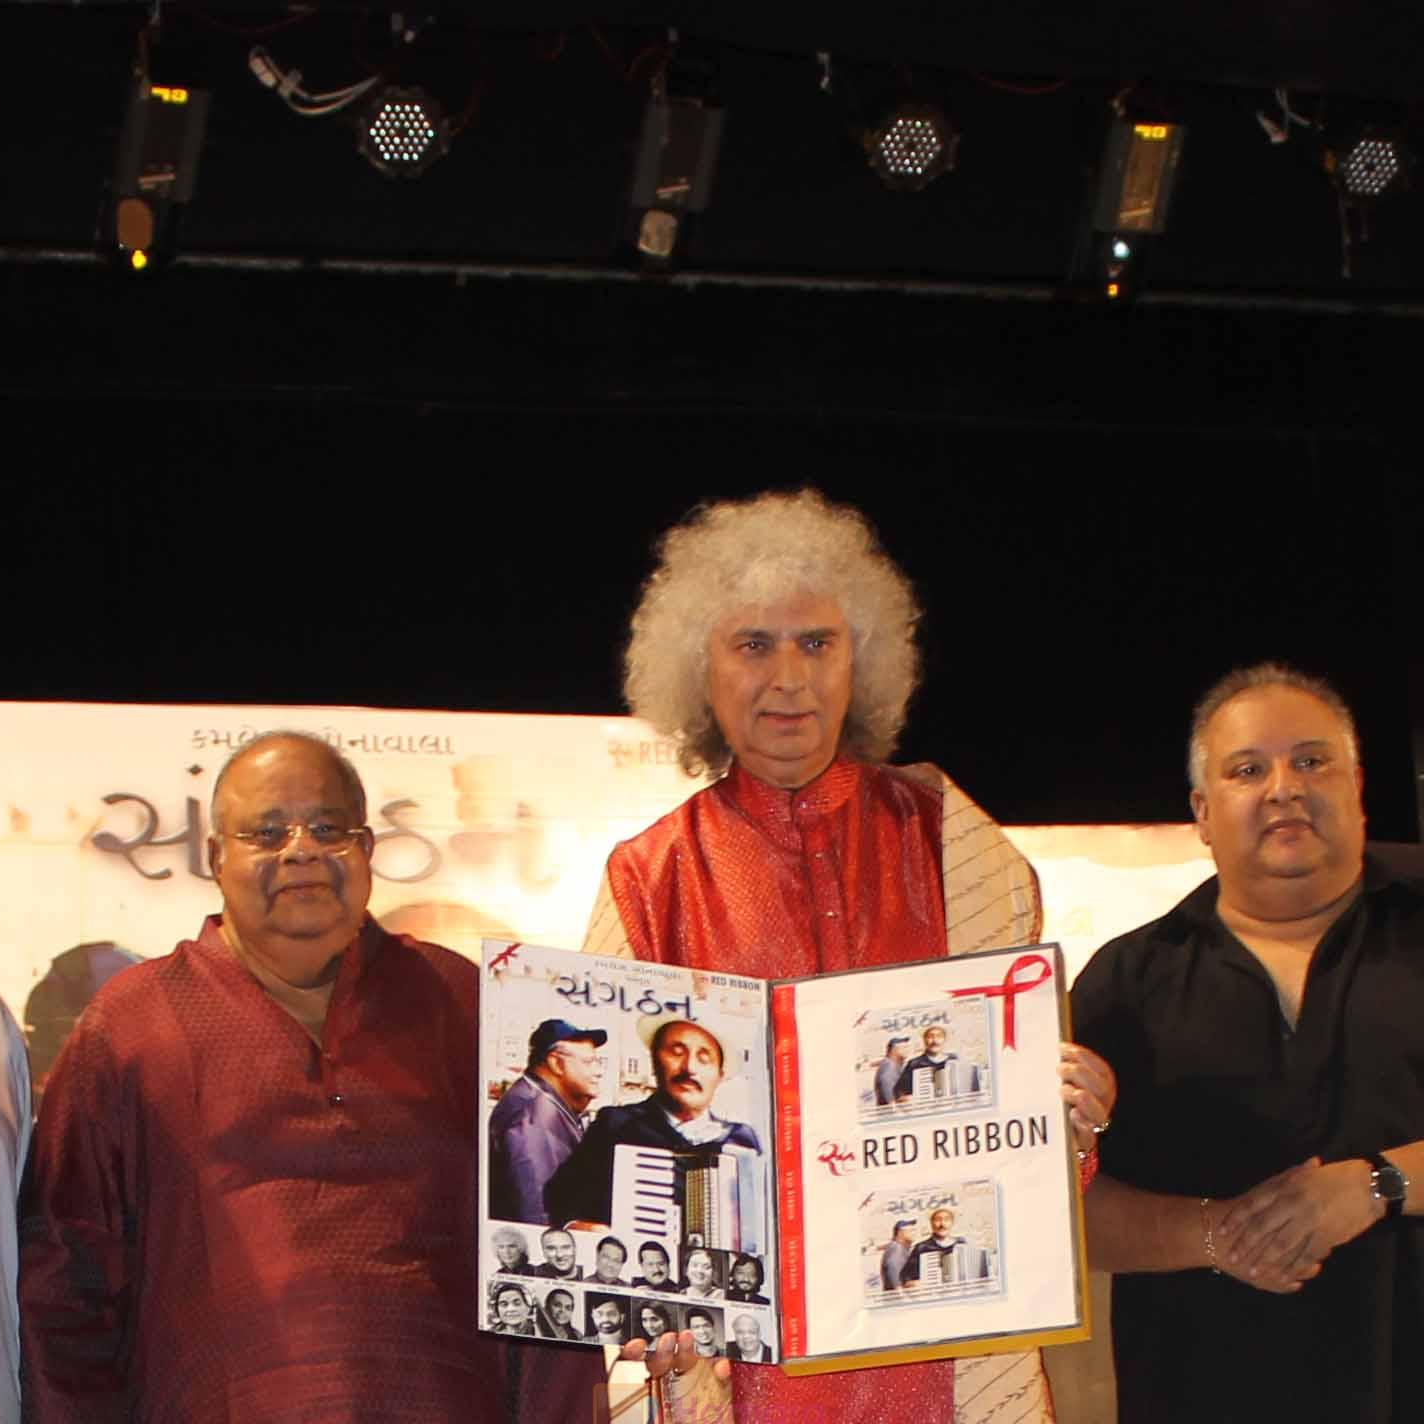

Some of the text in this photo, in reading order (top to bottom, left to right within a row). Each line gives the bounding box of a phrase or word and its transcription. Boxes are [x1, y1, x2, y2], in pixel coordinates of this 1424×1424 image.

[556, 970, 698, 1023] સંગઠન
[862, 1114, 1049, 1169] RED RIBBON
